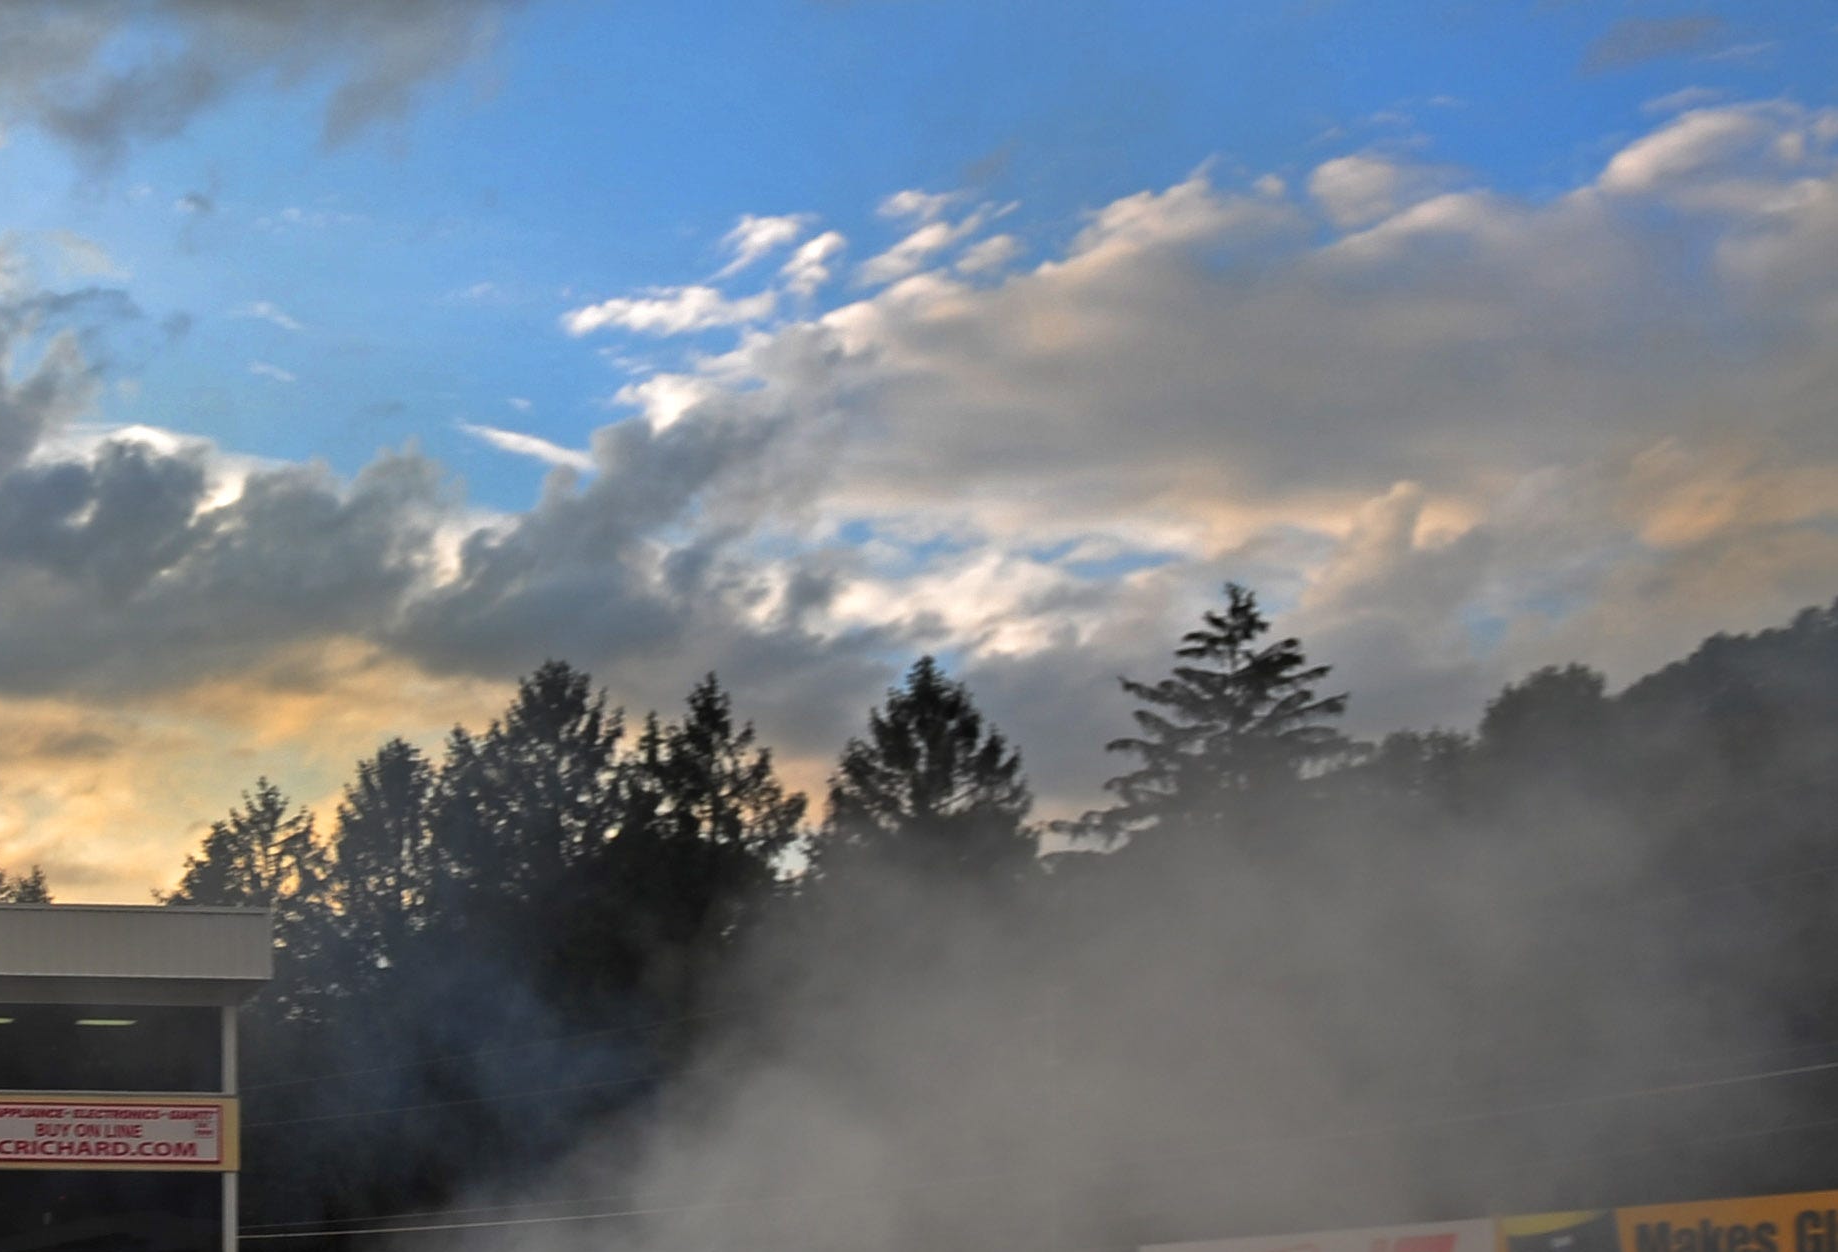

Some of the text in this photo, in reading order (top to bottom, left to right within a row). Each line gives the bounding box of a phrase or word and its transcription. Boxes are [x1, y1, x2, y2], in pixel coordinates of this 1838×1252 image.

[34, 1123, 143, 1139] BUY ON LINE
